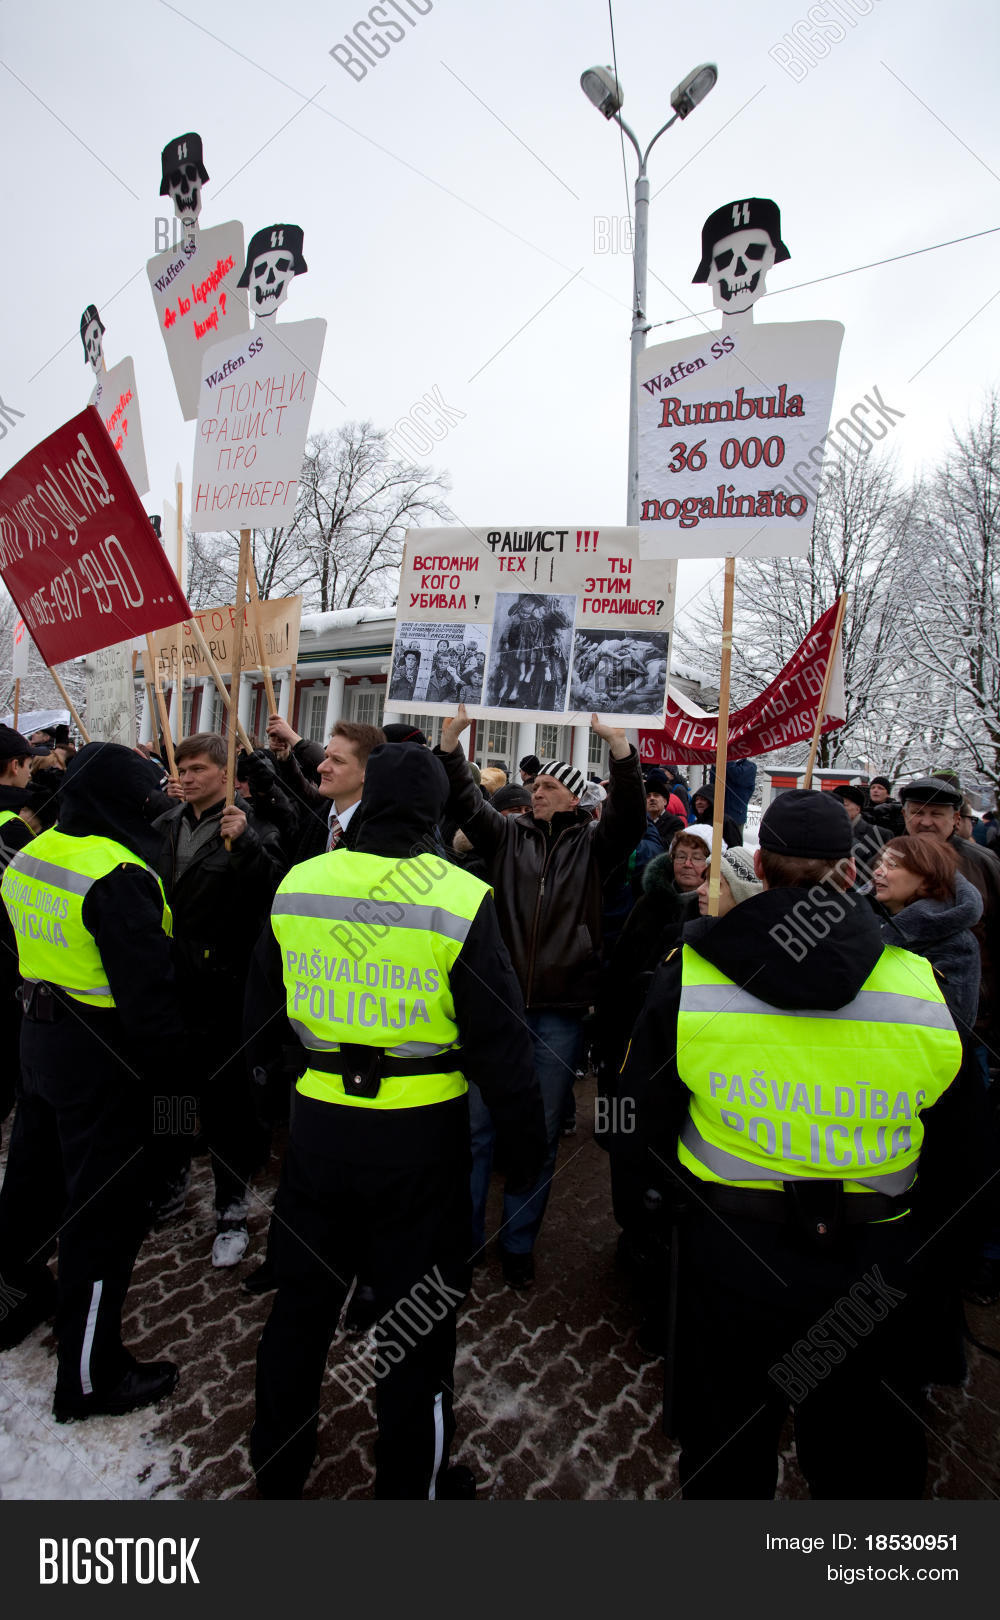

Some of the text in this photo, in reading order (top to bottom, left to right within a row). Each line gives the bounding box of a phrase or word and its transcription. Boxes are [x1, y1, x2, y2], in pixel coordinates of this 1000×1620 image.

[154, 239, 198, 293] Waffen SS
[204, 337, 264, 390] Waffen SS
[640, 336, 735, 396] Waffen SS
[657, 384, 805, 428] Rumbula
[217, 444, 257, 472] ПРО
[668, 436, 785, 473] 36 000
[640, 484, 808, 528] nogalināto
[487, 531, 569, 553] ФАШИСТ
[413, 556, 527, 572] ВСПОМНИ ТЕХ
[421, 574, 461, 590] КОГО
[608, 557, 633, 574] ТЫ
[409, 593, 468, 610] УБИВАЛ
[585, 577, 631, 594] ЭТИМ
[286, 948, 440, 993] PAŠVALDĪBAS
[294, 980, 431, 1030] POLICIJA
